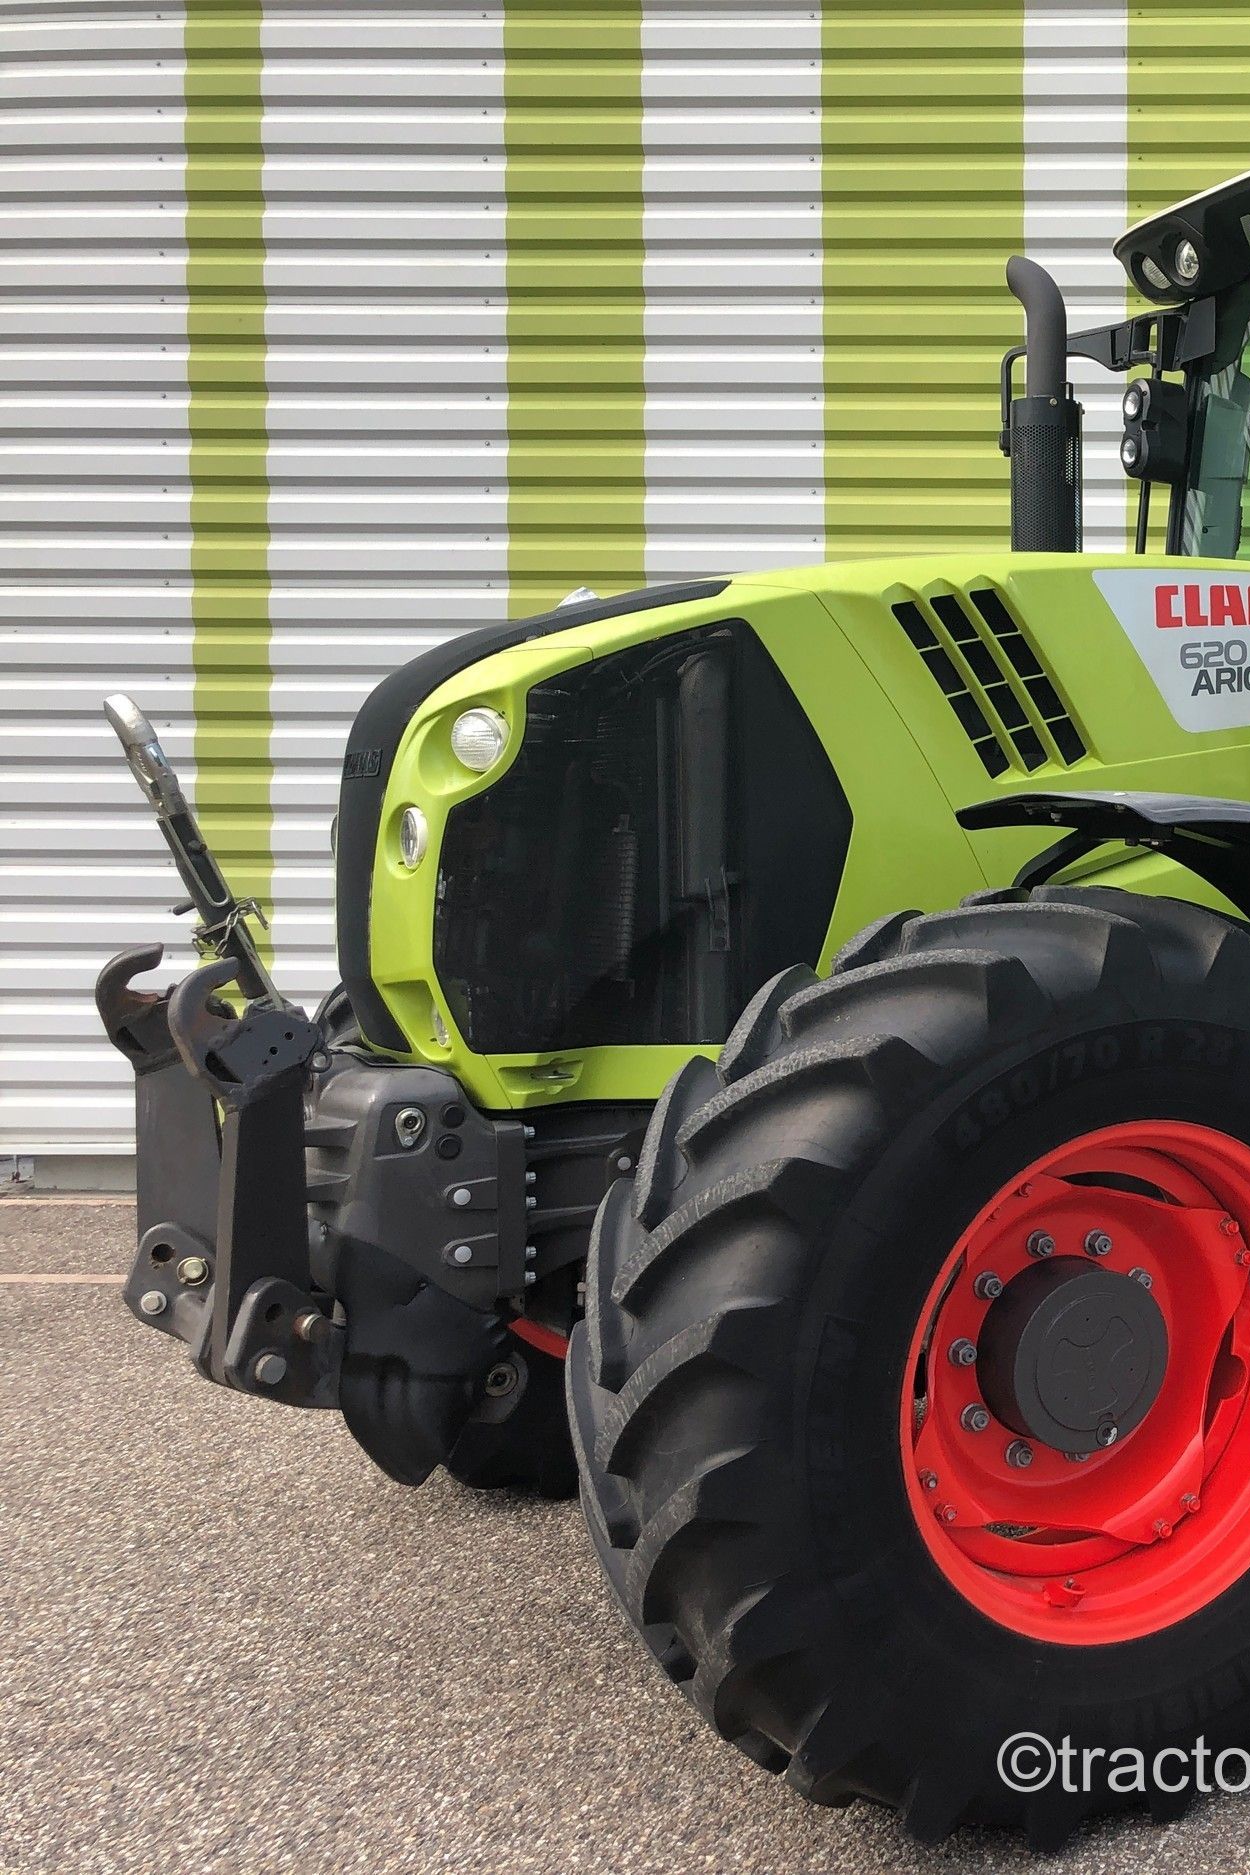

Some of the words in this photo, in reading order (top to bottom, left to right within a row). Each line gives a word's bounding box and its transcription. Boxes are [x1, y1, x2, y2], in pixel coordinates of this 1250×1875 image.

[1180, 639, 1248, 670] 620
[954, 1033, 1121, 1151] 480/70
[1137, 1026, 1167, 1062] R
